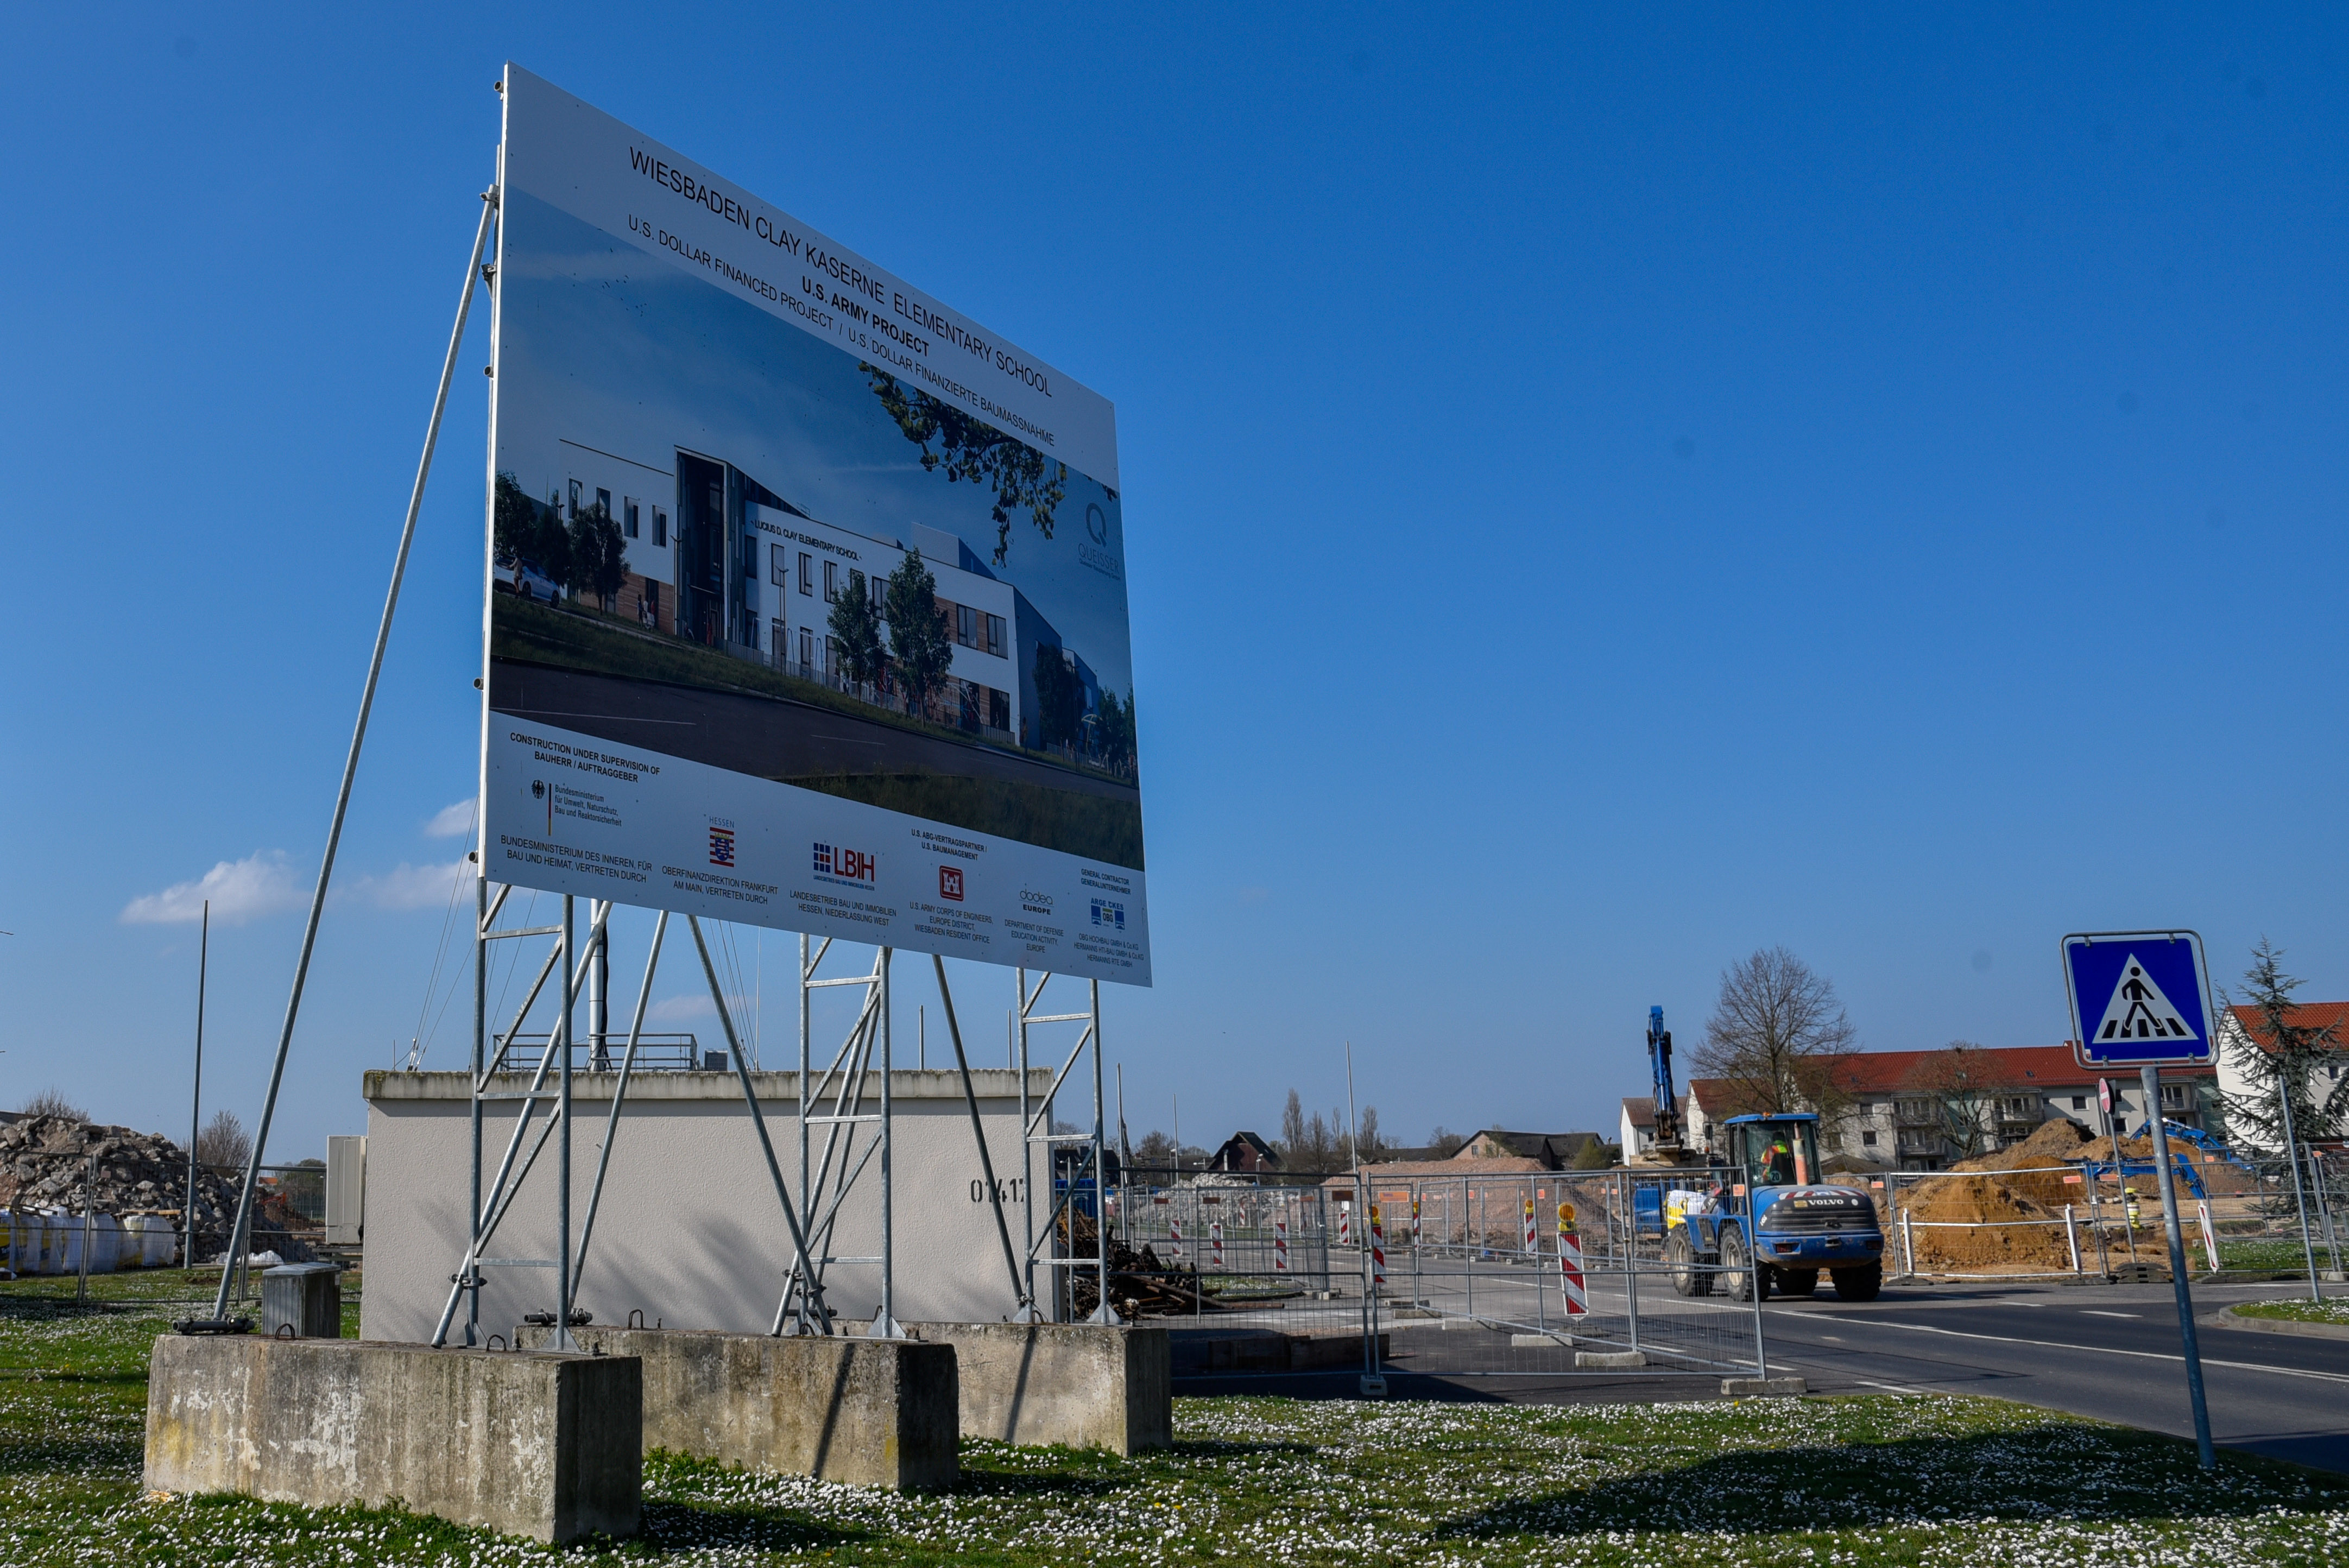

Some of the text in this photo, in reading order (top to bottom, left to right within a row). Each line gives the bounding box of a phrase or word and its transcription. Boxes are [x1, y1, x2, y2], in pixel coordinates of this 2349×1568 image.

[630, 146, 1052, 397] WIESBADEN CLAY KASERNE ELEMENTARY SCHOOL
[803, 275, 929, 357] U.S. ARMY PROJECT
[628, 214, 654, 241] U.S.
[659, 230, 711, 270] DOLLAR
[715, 258, 776, 302] FINANCED
[781, 292, 833, 331] PROJECT
[848, 328, 869, 351] U.S.
[872, 339, 913, 375] DOLLAR
[915, 362, 978, 407] FINANZIERTE
[981, 396, 1054, 446] BAUMASSNAHME
[755, 519, 776, 533] LUCIUS
[776, 527, 782, 536] D.
[784, 529, 798, 541] CLAY
[799, 534, 835, 553] ELEMENTARY
[836, 547, 859, 561] SCHOOL
[510, 732, 660, 775] CONSTRUCTION UNDER SUPERVISION OF
[534, 751, 572, 767] BAUHERR
[578, 762, 638, 783] AUFTRAGGEBER
[555, 785, 604, 802] Bundesministerium
[555, 806, 622, 826] Bau und Reaktorsicherheit
[564, 798, 585, 809] Umwelt,
[587, 802, 618, 816] Naturschutz,
[709, 816, 734, 828] HESSEN
[911, 829, 921, 838] U.S.
[923, 831, 984, 851] ABG-VERTRAGSPARTNER
[501, 834, 652, 871] BUNDESMINISTERIUM DES INNEREN, FÜR
[921, 842, 978, 861] U.S. BAUMANAGEMENT
[507, 850, 646, 883] BAU UND HEIMAT, VERTRETEN DURCH
[835, 847, 874, 882] LBIH
[662, 866, 778, 895] OBERFINANZDIREKTION FRANKFURT
[1081, 869, 1129, 885] GENERAL CONTRACTOR
[1081, 878, 1131, 895] GENERALUNTERNEHMER
[673, 881, 768, 905] AM MAIN, VERTRETEN DURCH
[1020, 889, 1053, 905] dodea
[1091, 897, 1106, 906] ARGE
[790, 890, 896, 916] LANDESBETRIEB BAU UND IMMOBILIEN
[1023, 904, 1051, 915] EUROPE
[798, 903, 889, 926] HESSEN, NIEDERLASSUNG WEST
[910, 901, 920, 911] U.S.
[921, 903, 936, 913] ARMY
[937, 907, 954, 916] CORPS
[964, 912, 993, 925] ENGINEERS,
[1103, 913, 1113, 922] OBG
[930, 916, 975, 931] EUROPE DISTRICT,
[1005, 919, 1035, 931] DEPARTMENT
[1044, 926, 1064, 937] DEFENSE
[914, 924, 990, 944] WIESBADEN RESIDENT OFFICE
[1011, 931, 1037, 942] EDUCATION
[1089, 935, 1109, 945] HOCHBAU
[1026, 944, 1045, 953] EUROPE
[1074, 942, 1097, 952] HERMANNS
[1087, 954, 1111, 964] HERMANNS
[1771, 1173, 1779, 1181] 20
